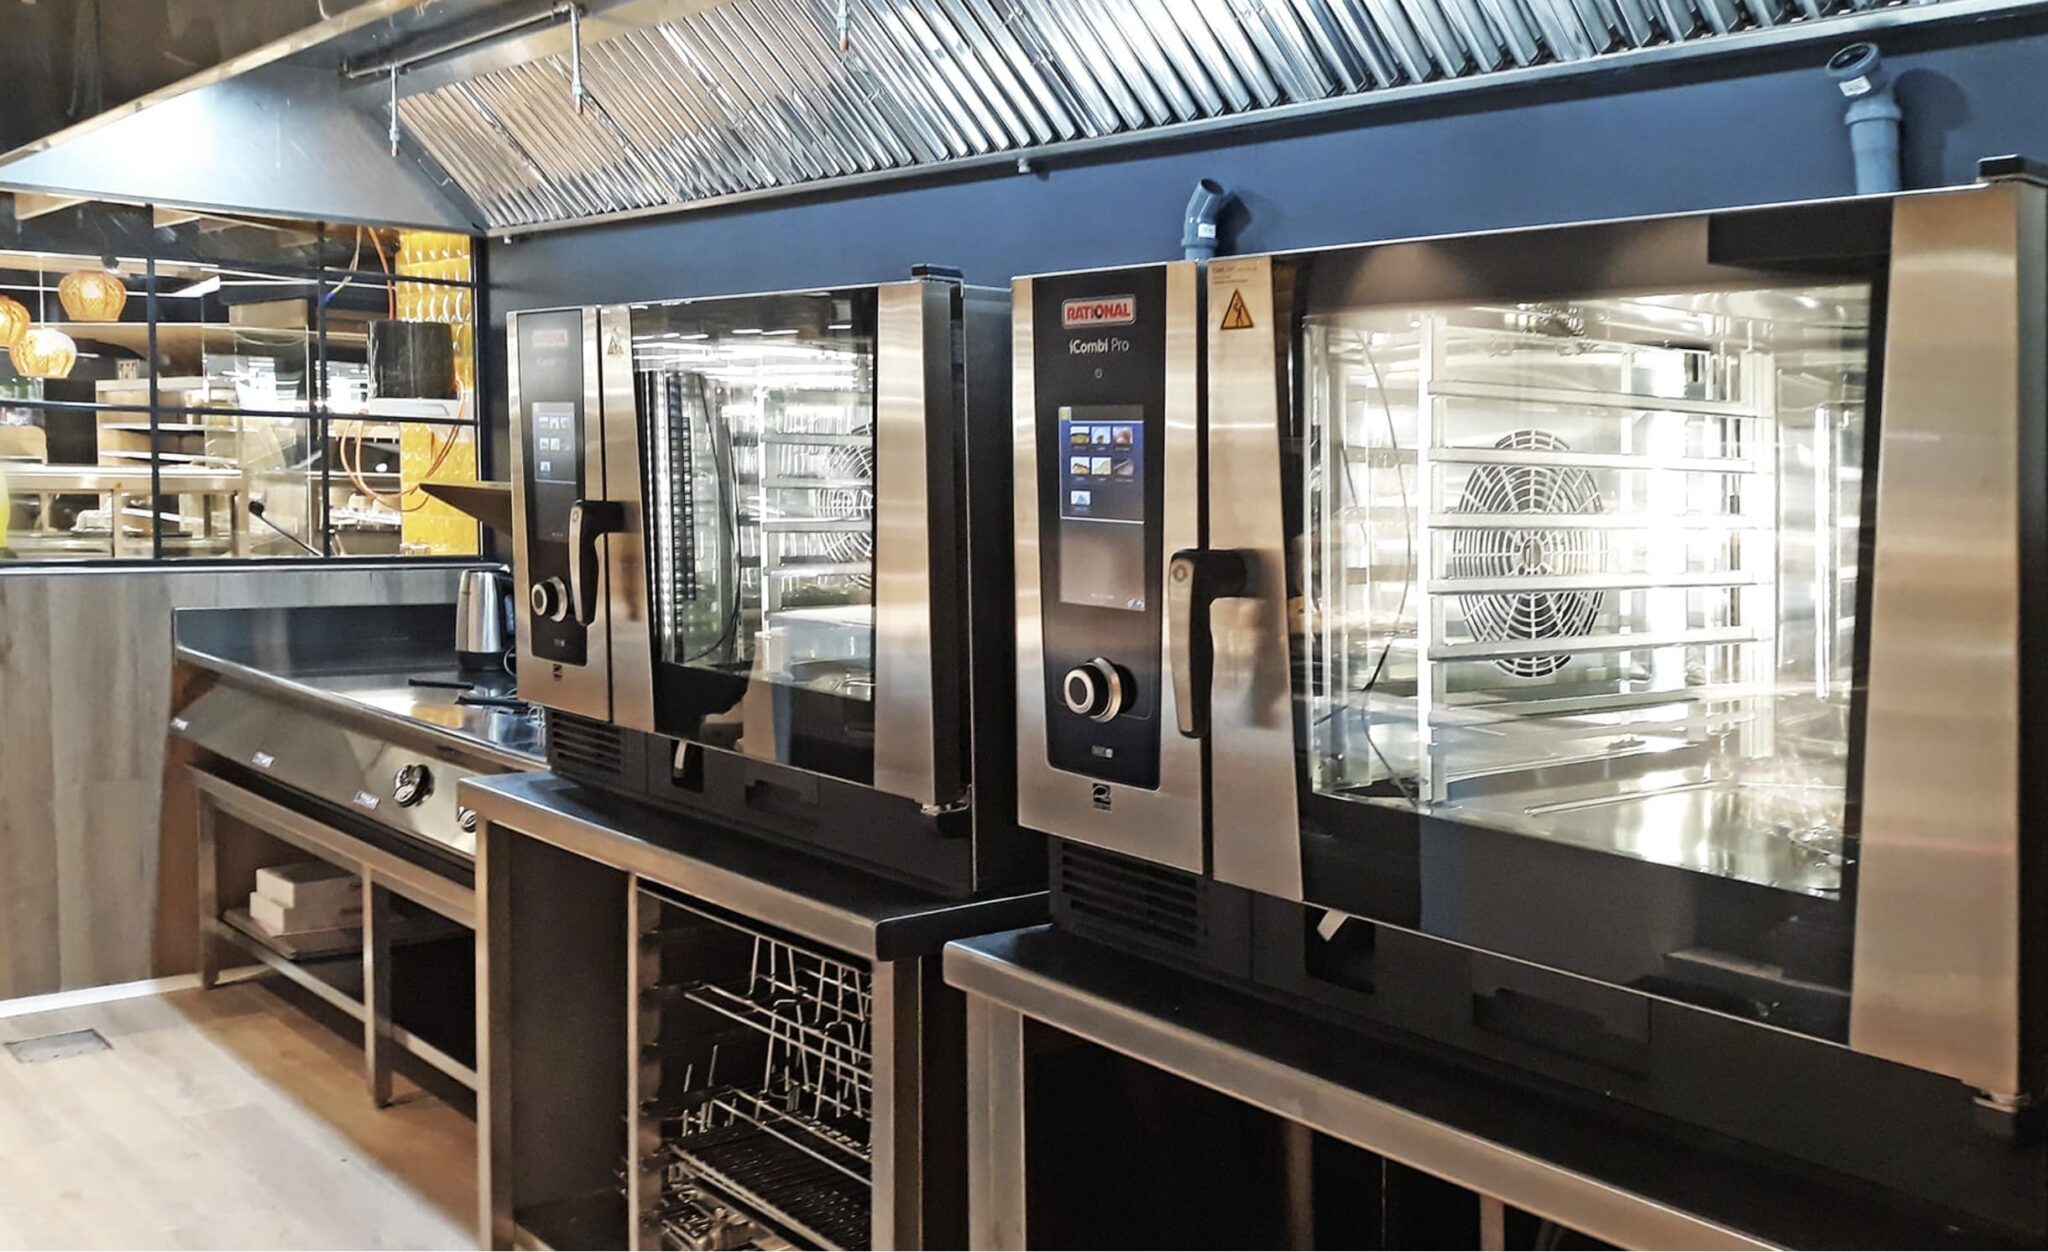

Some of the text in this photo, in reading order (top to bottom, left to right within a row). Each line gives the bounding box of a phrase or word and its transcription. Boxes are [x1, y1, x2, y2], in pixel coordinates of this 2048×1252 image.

[1067, 303, 1130, 321] RATIONAL
[1069, 337, 1130, 354] iCombi Pro
